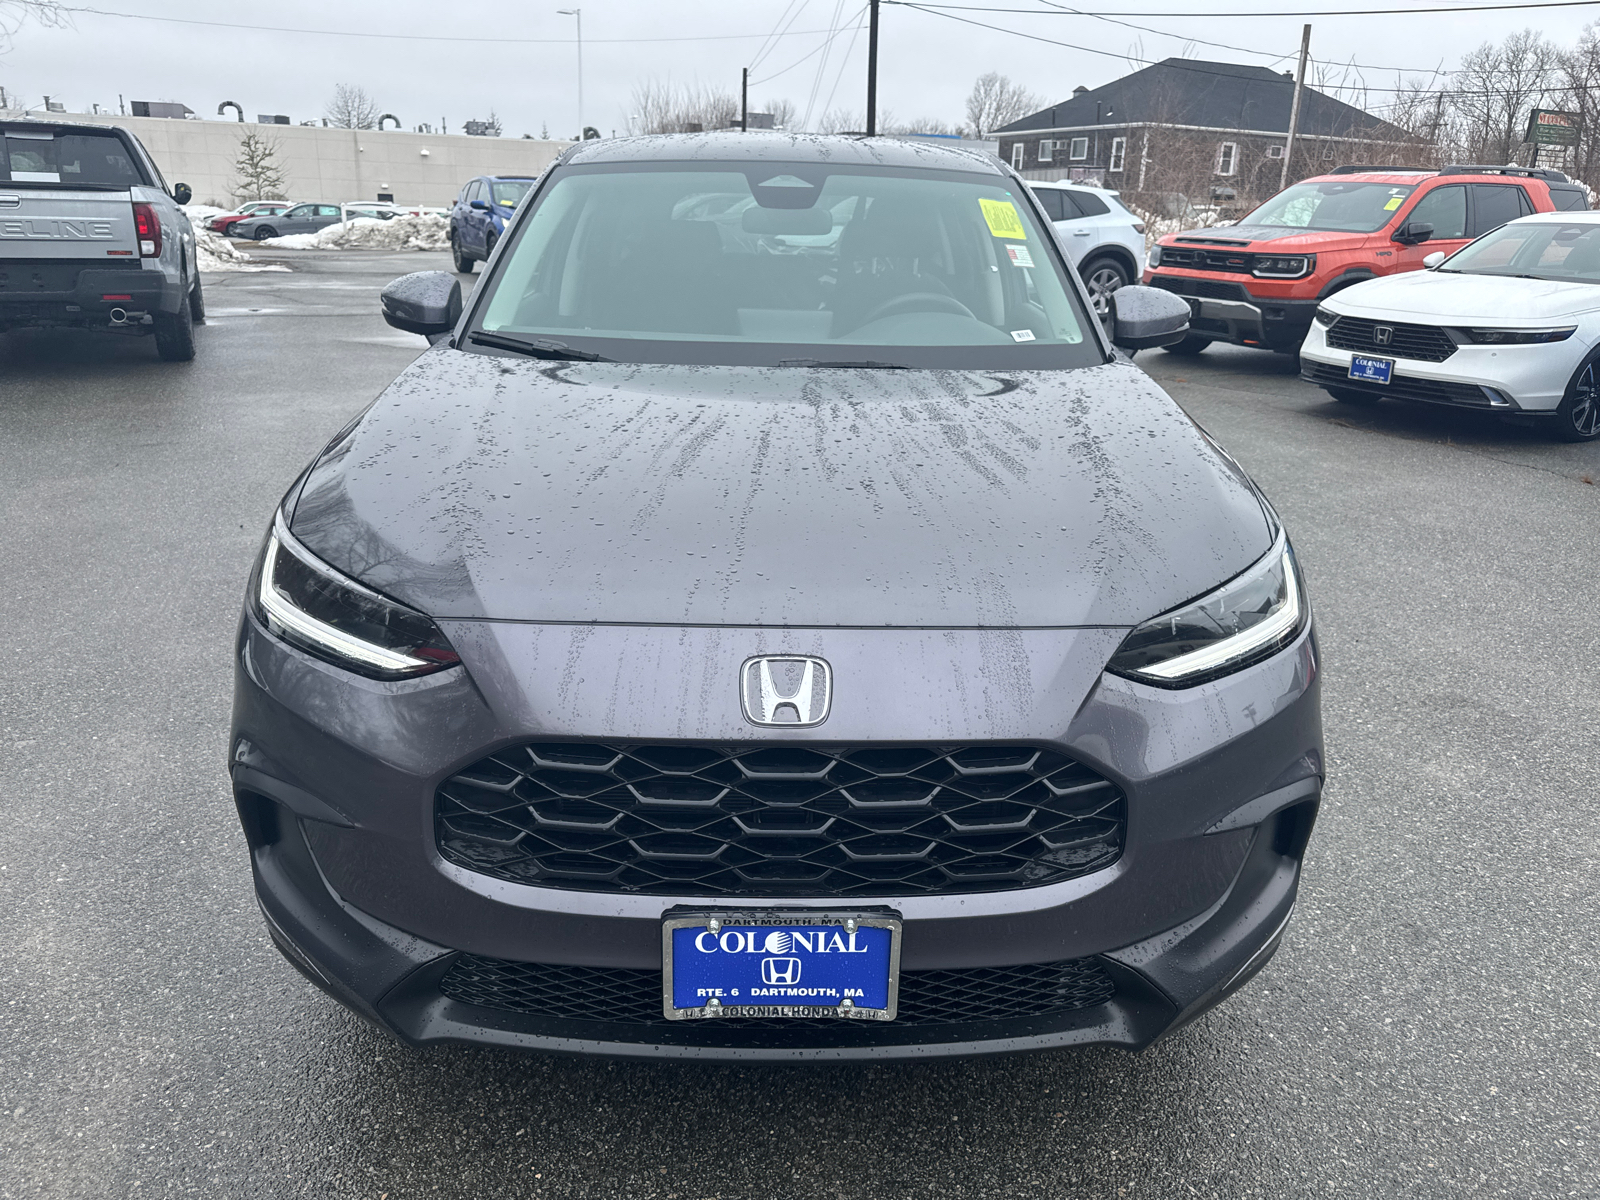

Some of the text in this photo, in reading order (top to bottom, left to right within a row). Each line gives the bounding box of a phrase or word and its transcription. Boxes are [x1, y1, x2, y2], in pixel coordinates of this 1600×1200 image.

[723, 918, 816, 926] DARTMOUTH,
[694, 931, 868, 954] COLONIAL
[697, 988, 739, 997] RTE. 6
[751, 988, 864, 998] DARTMOUTH, MA
[722, 1006, 838, 1017] COLONIAL HONDA
